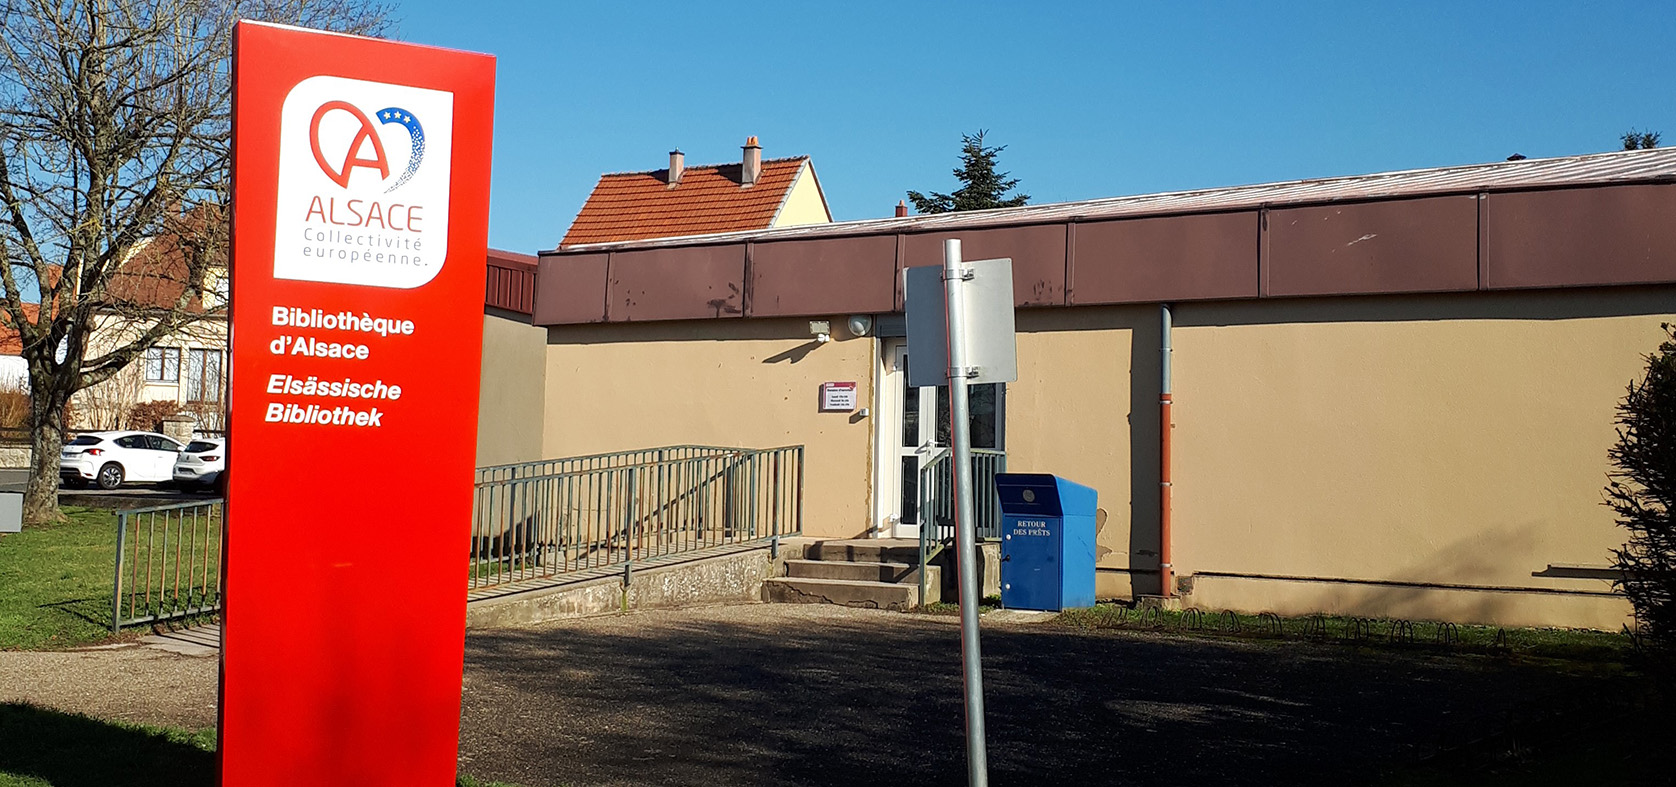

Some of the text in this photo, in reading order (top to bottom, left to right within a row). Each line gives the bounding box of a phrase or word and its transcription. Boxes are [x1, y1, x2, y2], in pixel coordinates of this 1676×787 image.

[305, 196, 423, 232] ALSACE
[304, 228, 422, 251] Collectivité
[303, 246, 428, 267] européenne.
[272, 306, 415, 336] Bibliothèque
[269, 336, 370, 360] d’Alsace
[266, 374, 402, 400] Elsässische
[265, 403, 383, 427] Bibliothek
[1013, 528, 1051, 537] DES PRÊTS
[1017, 520, 1046, 528] RETOUR
